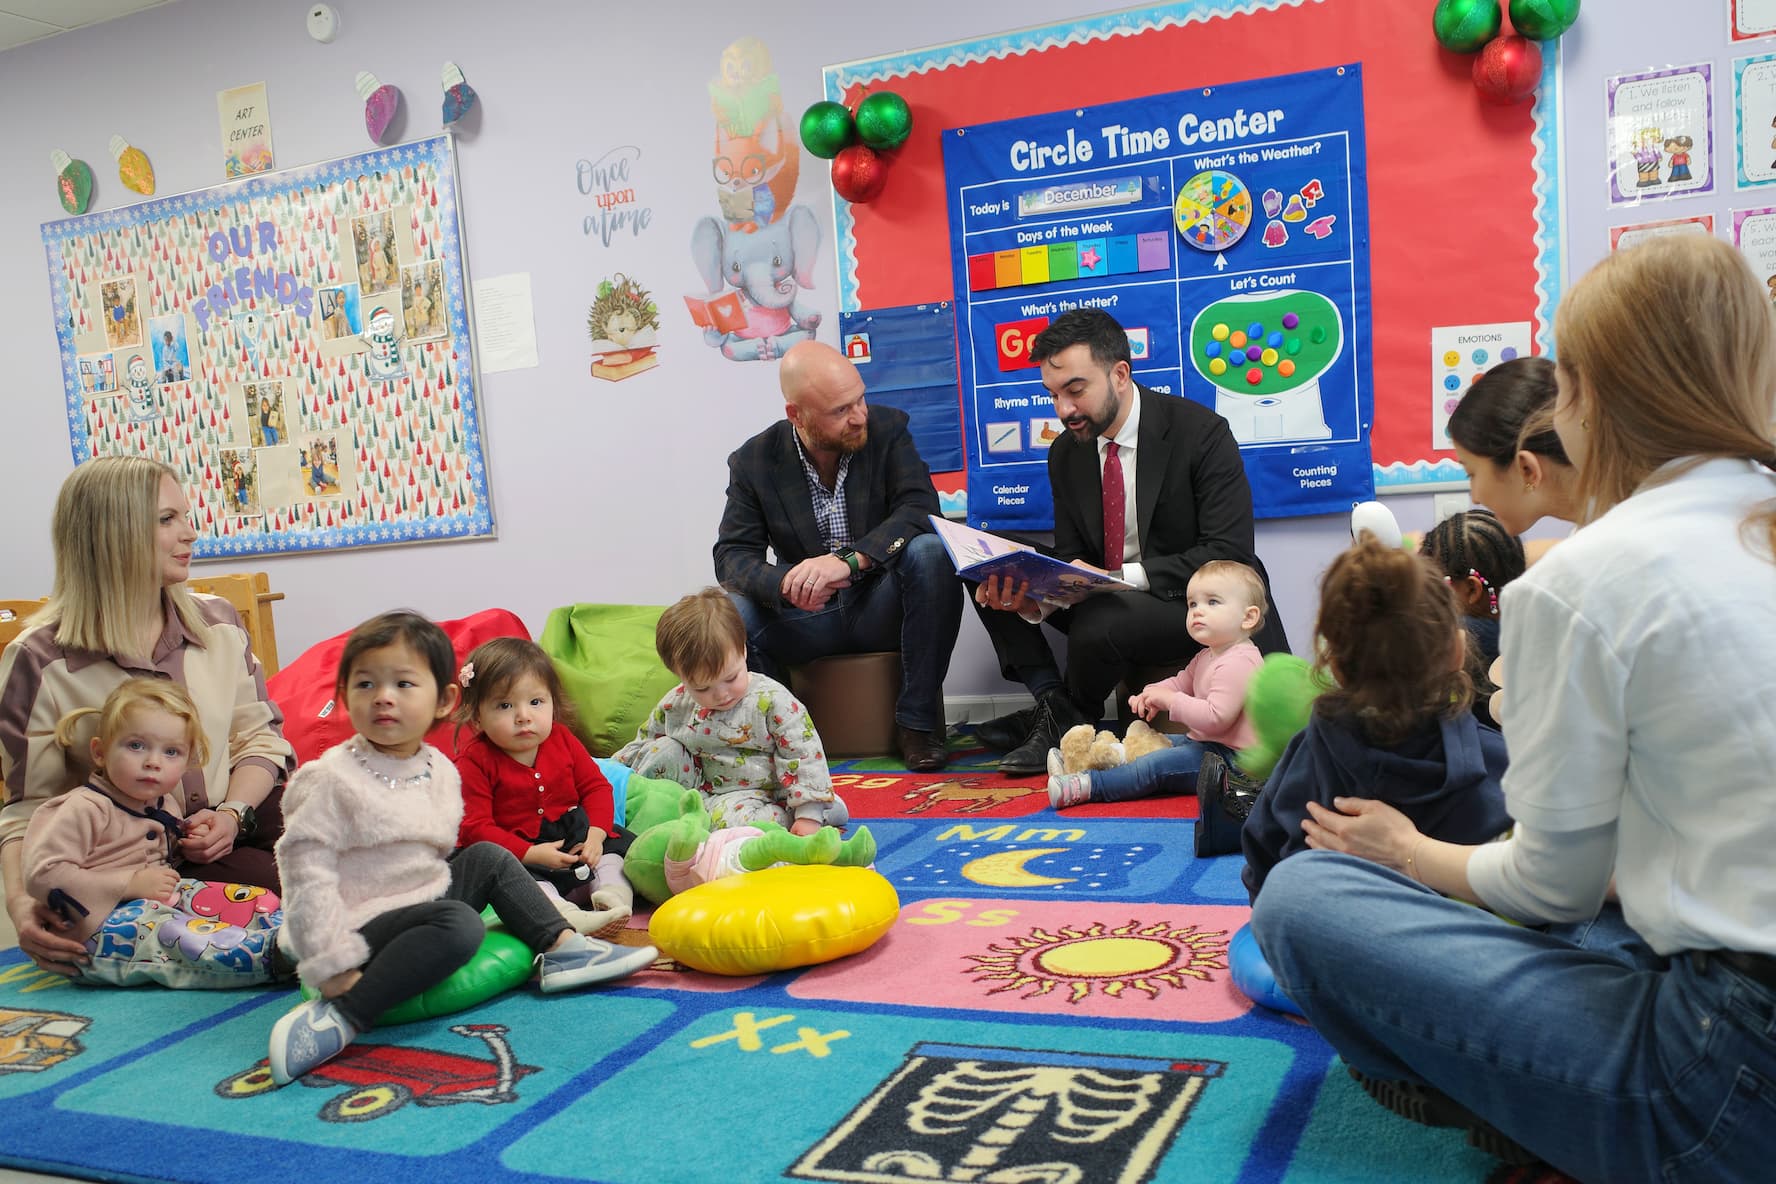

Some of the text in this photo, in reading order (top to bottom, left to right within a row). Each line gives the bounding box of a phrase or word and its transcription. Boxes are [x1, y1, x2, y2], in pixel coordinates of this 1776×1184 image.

[1640, 86, 1659, 97] We
[1661, 82, 1690, 94] listen
[235, 106, 255, 121] ART
[1631, 97, 1687, 112] and follow
[229, 124, 265, 143] CENTER
[1010, 108, 1285, 172] Circle Time Center
[1194, 141, 1322, 171] What's the Weather?
[576, 146, 641, 195] Once
[594, 187, 636, 212] upon
[970, 183, 1118, 217] Today is December
[583, 207, 653, 248] a time
[1017, 219, 1114, 244] Days of the Week
[208, 220, 278, 264] OUR
[1230, 271, 1297, 291] Let's Count
[192, 265, 315, 333] FRIENDS
[1021, 294, 1119, 317] What's the Letter?
[1458, 333, 1503, 345] EMOTIONS
[994, 396, 1029, 411] Rhyme
[1292, 464, 1338, 478] Counting
[992, 484, 1030, 495] Calendar
[1300, 478, 1332, 489] Pieces
[997, 495, 1026, 506] Pieces
[936, 824, 1088, 842] Mm
[906, 901, 1020, 927] Ss
[689, 1011, 852, 1058] Xx
